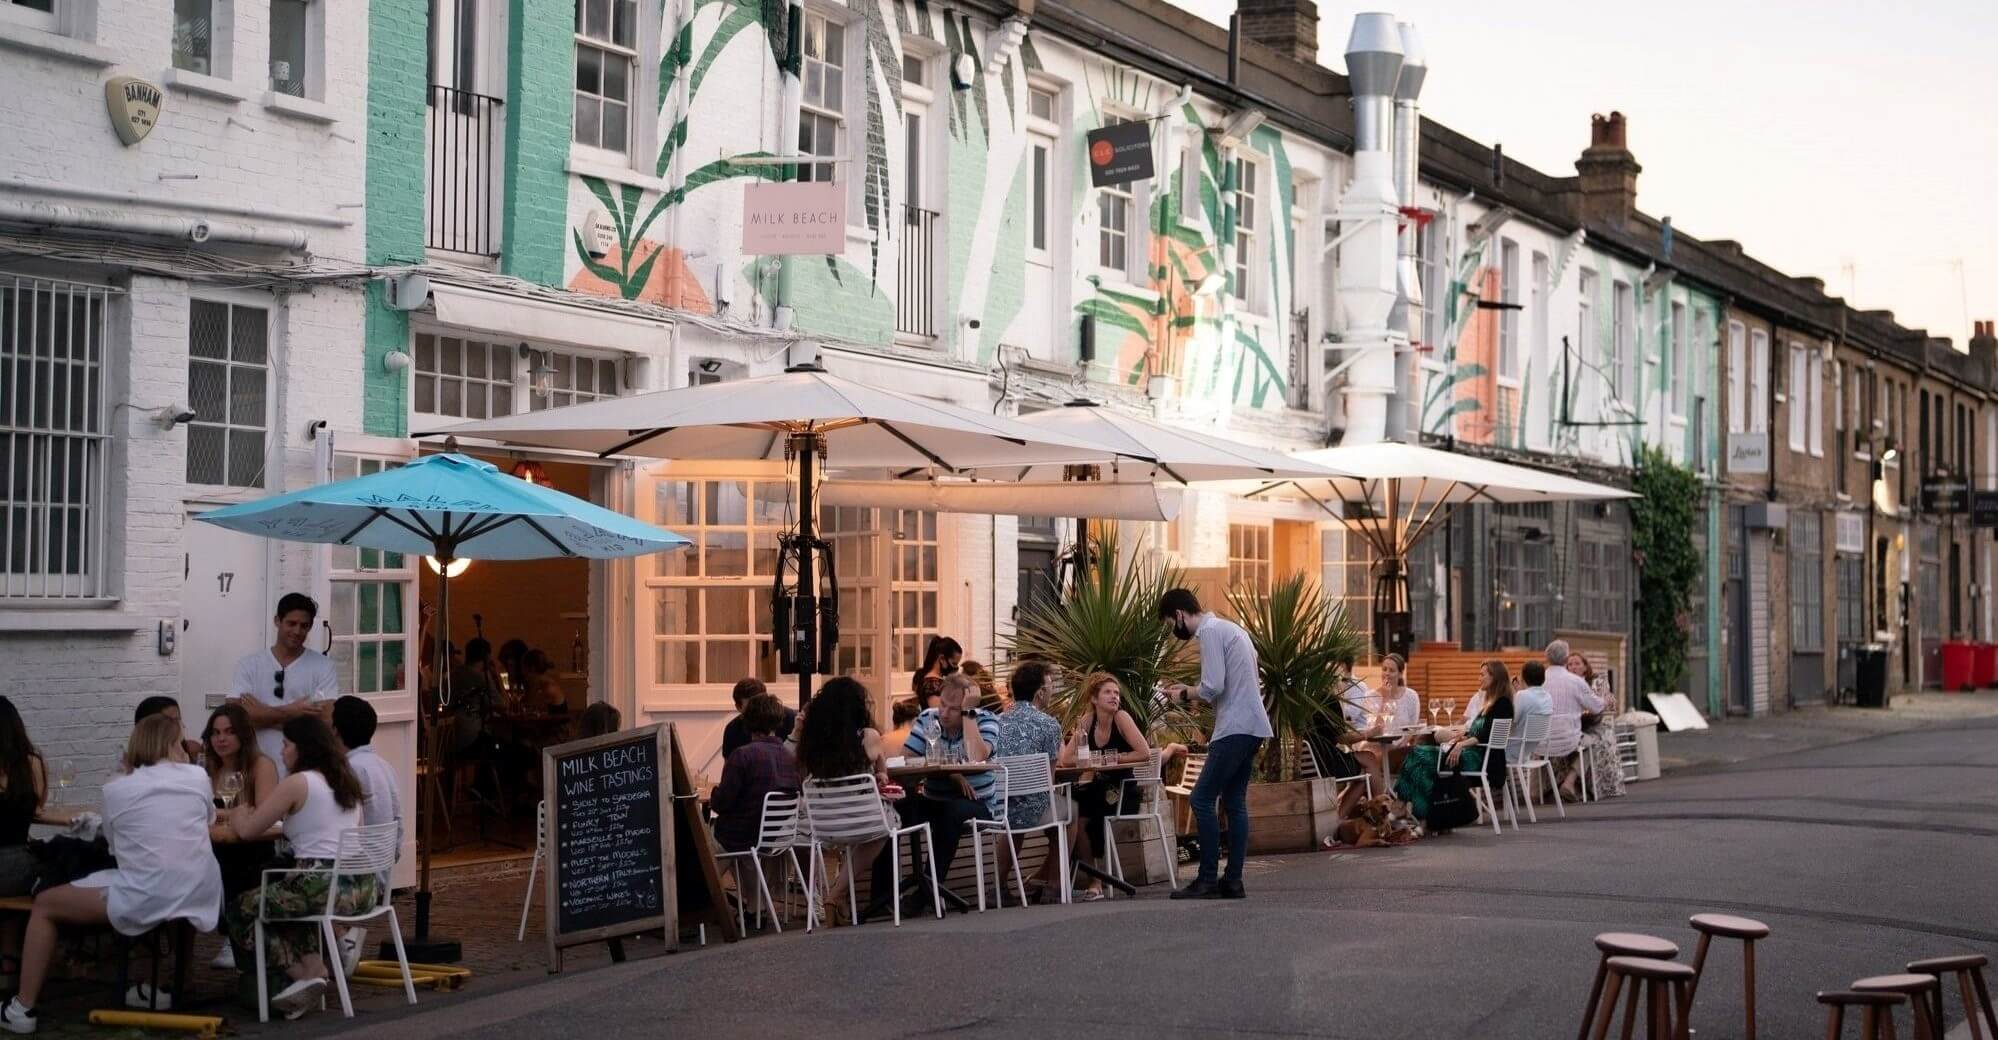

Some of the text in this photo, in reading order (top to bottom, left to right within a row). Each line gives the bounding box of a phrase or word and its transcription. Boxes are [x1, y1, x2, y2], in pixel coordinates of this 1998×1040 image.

[125, 85, 160, 109] BANHAM
[750, 212, 838, 225] MILK BEACH
[217, 572, 235, 592] 17
[563, 745, 647, 776] MILK BEACH
[564, 766, 653, 796] WINE TASTINGS
[572, 818, 599, 829] FUNKY
[570, 856, 597, 867] MEET
[569, 874, 609, 889] NORTHERN
